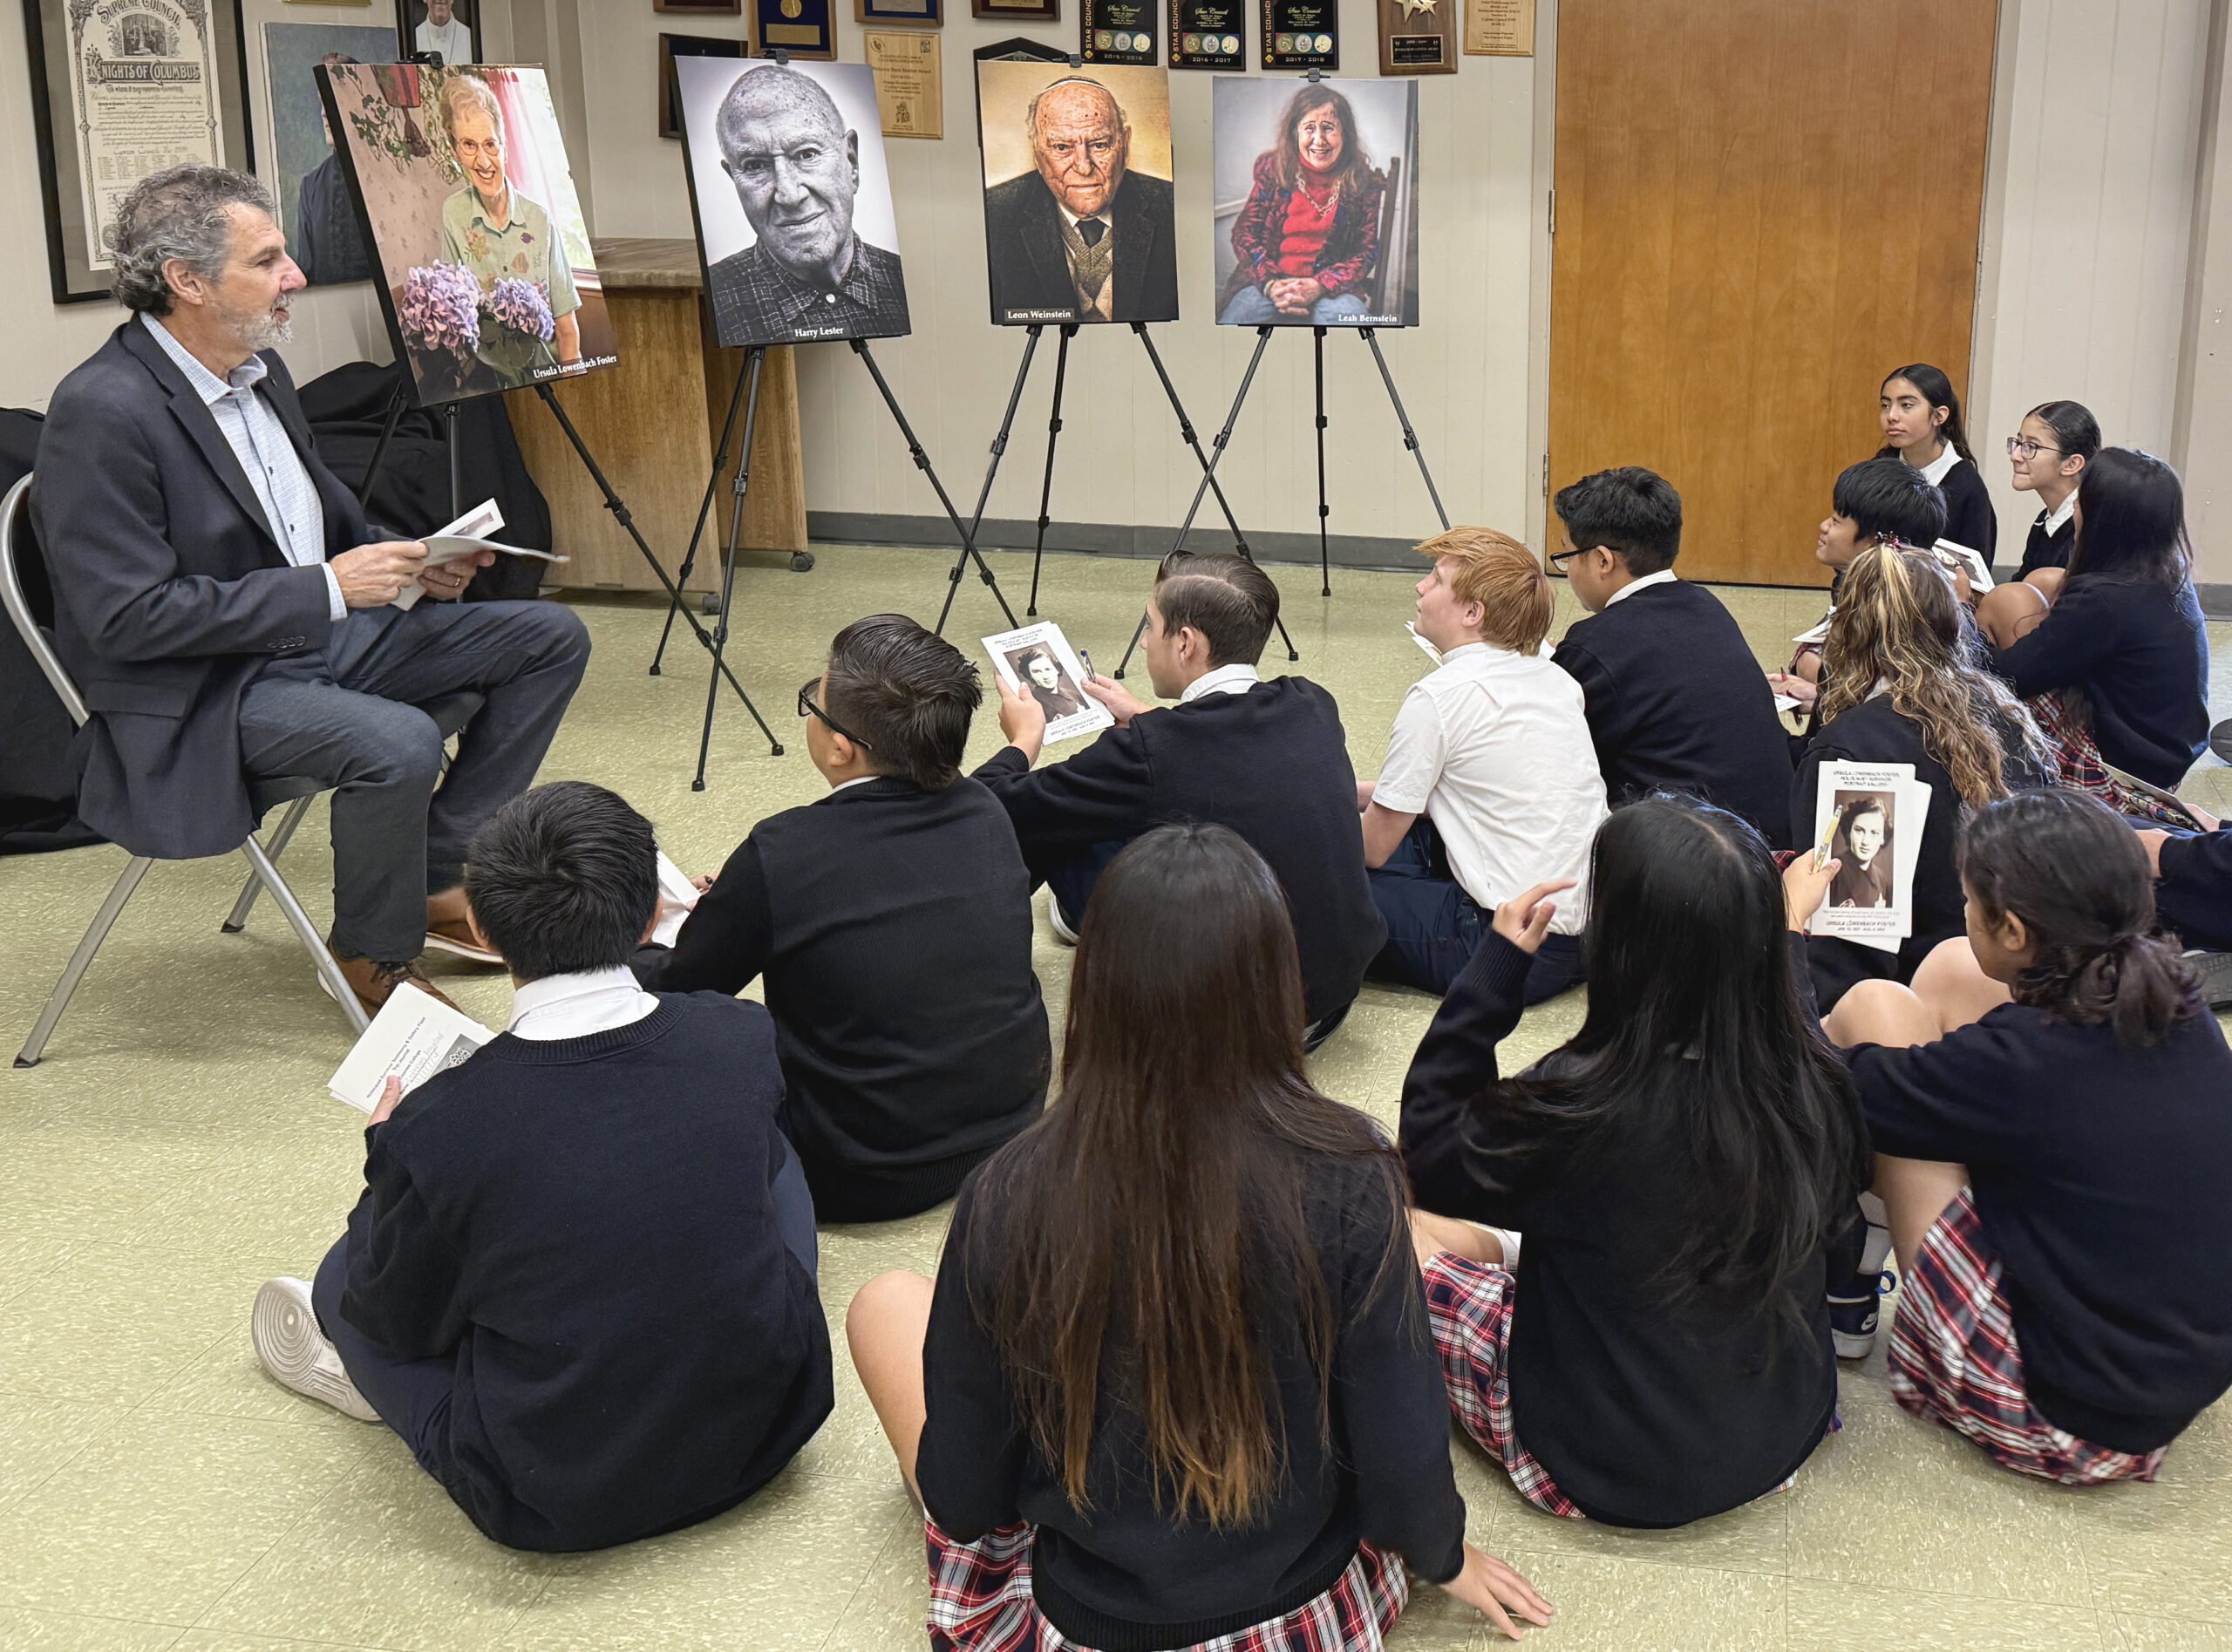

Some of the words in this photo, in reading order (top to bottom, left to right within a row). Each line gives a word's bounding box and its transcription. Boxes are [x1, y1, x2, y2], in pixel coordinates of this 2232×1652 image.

[85, 56, 135, 83] KNIGHTS
[136, 65, 148, 78] OF
[150, 59, 201, 85] COLUMBUS
[1007, 310, 1029, 319] Leon
[1031, 310, 1071, 319] Weinstein
[1360, 314, 1398, 323] Bernstein
[794, 328, 818, 339] Harry
[820, 327, 844, 336] Lester
[533, 366, 558, 378] Ursula
[558, 357, 596, 374] Lowenbach
[596, 356, 617, 366] Foster
